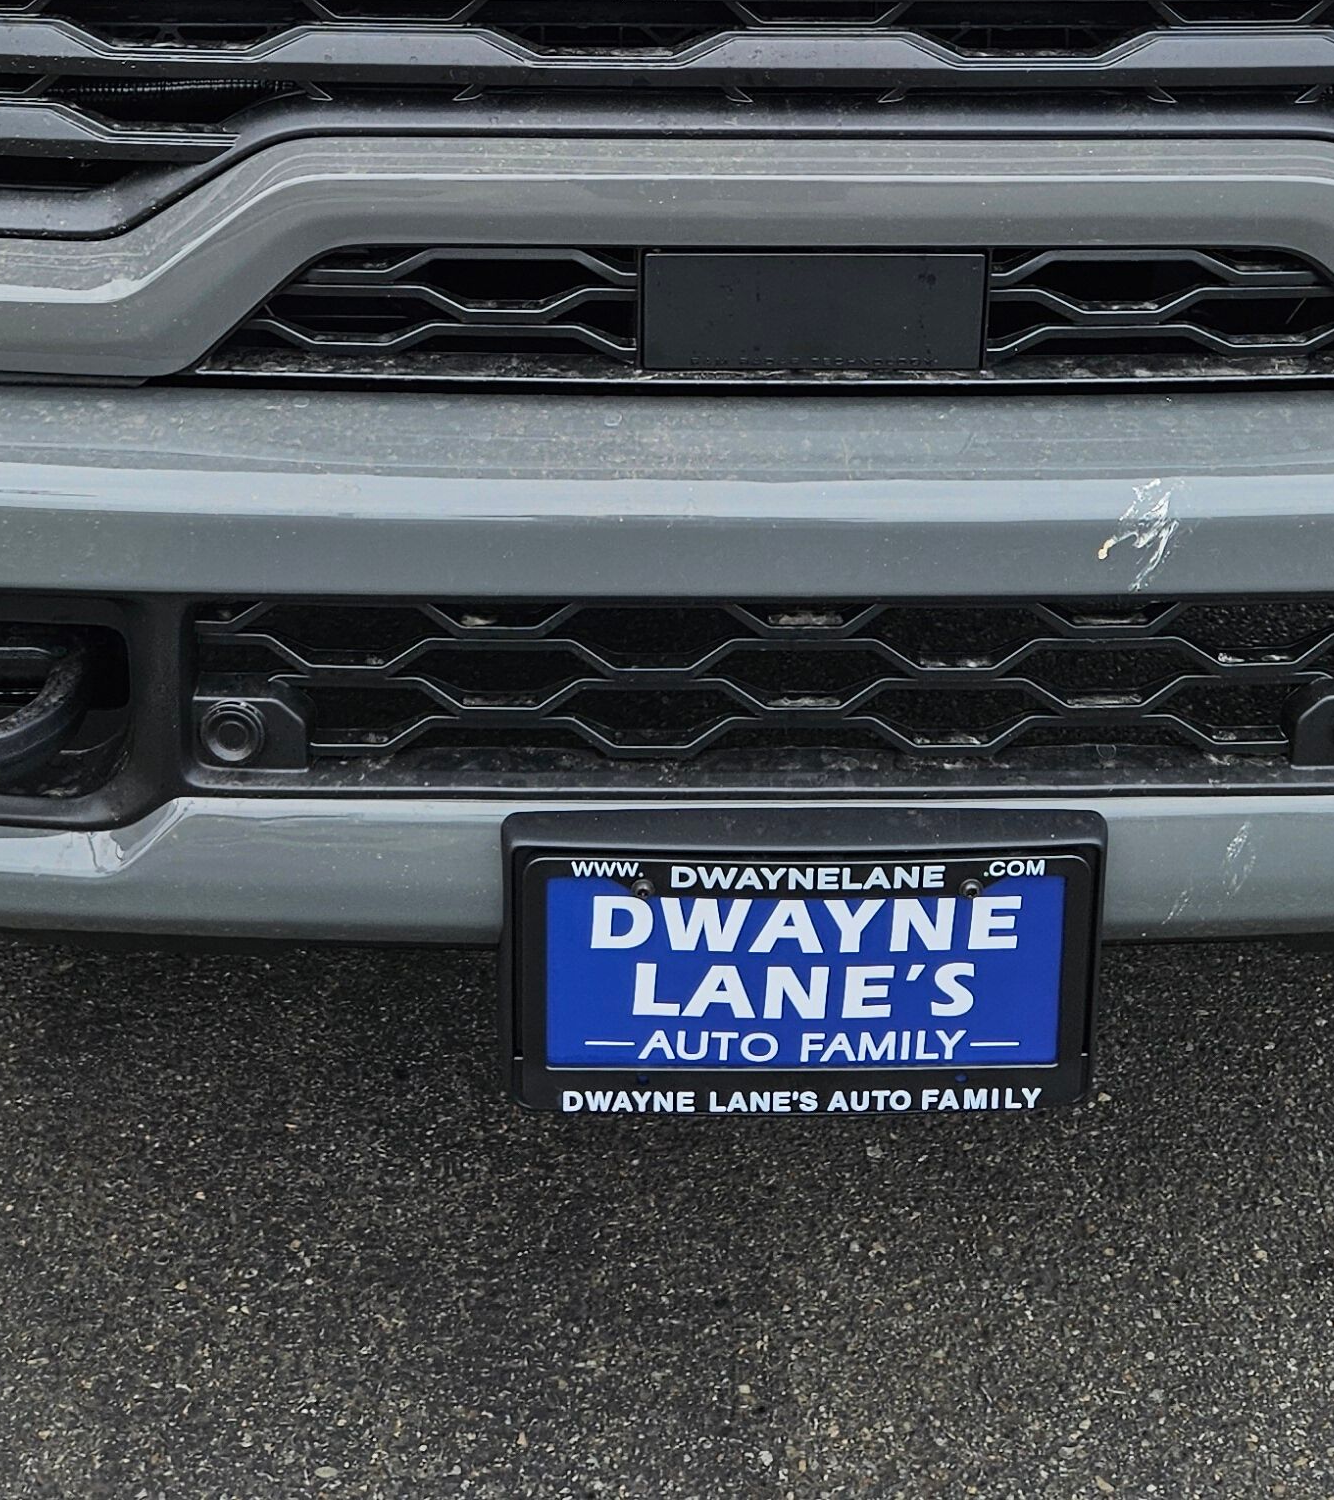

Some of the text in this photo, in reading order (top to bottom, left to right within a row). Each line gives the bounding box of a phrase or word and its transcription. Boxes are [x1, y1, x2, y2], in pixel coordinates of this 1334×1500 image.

[571, 859, 1046, 890] WWW. DWAYNELANE .COM
[590, 895, 1022, 953] DWAYNE
[632, 962, 975, 1019] LANE'S
[638, 1029, 967, 1063] AUTO FAMILY
[562, 1087, 1042, 1113] DWAYNE LANE'S AUTO FAMILY
